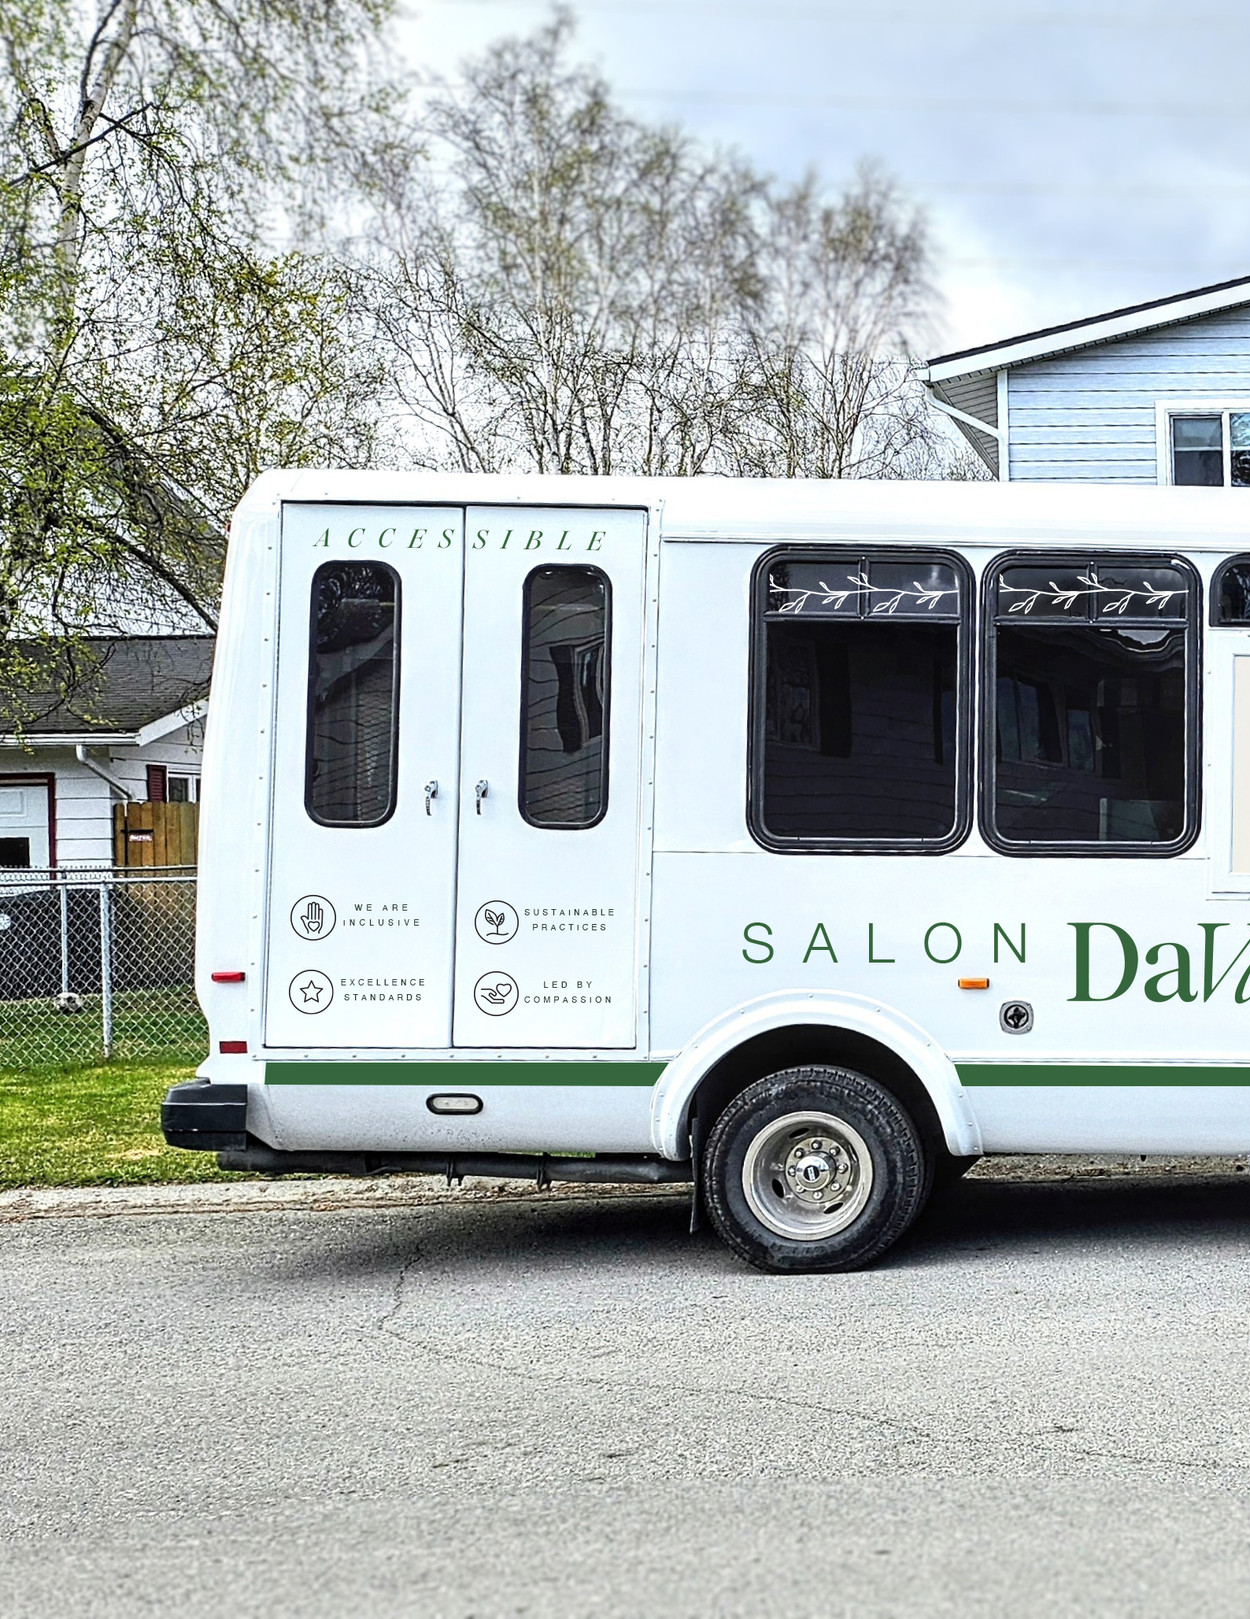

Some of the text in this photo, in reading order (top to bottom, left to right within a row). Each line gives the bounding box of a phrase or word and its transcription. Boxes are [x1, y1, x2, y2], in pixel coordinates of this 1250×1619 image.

[313, 527, 607, 551] ACCESSIBLE
[354, 903, 409, 912] WE ARE
[524, 908, 615, 917] SUSTAINABLE
[342, 918, 420, 927] INCLUSIVE
[532, 923, 607, 932] PRACTICES
[742, 920, 1027, 965] SALON
[340, 978, 426, 987] EXCELLENCE
[543, 980, 593, 989] LED BY
[343, 993, 422, 1002] STANDARDS
[523, 995, 612, 1004] COMPASSION
